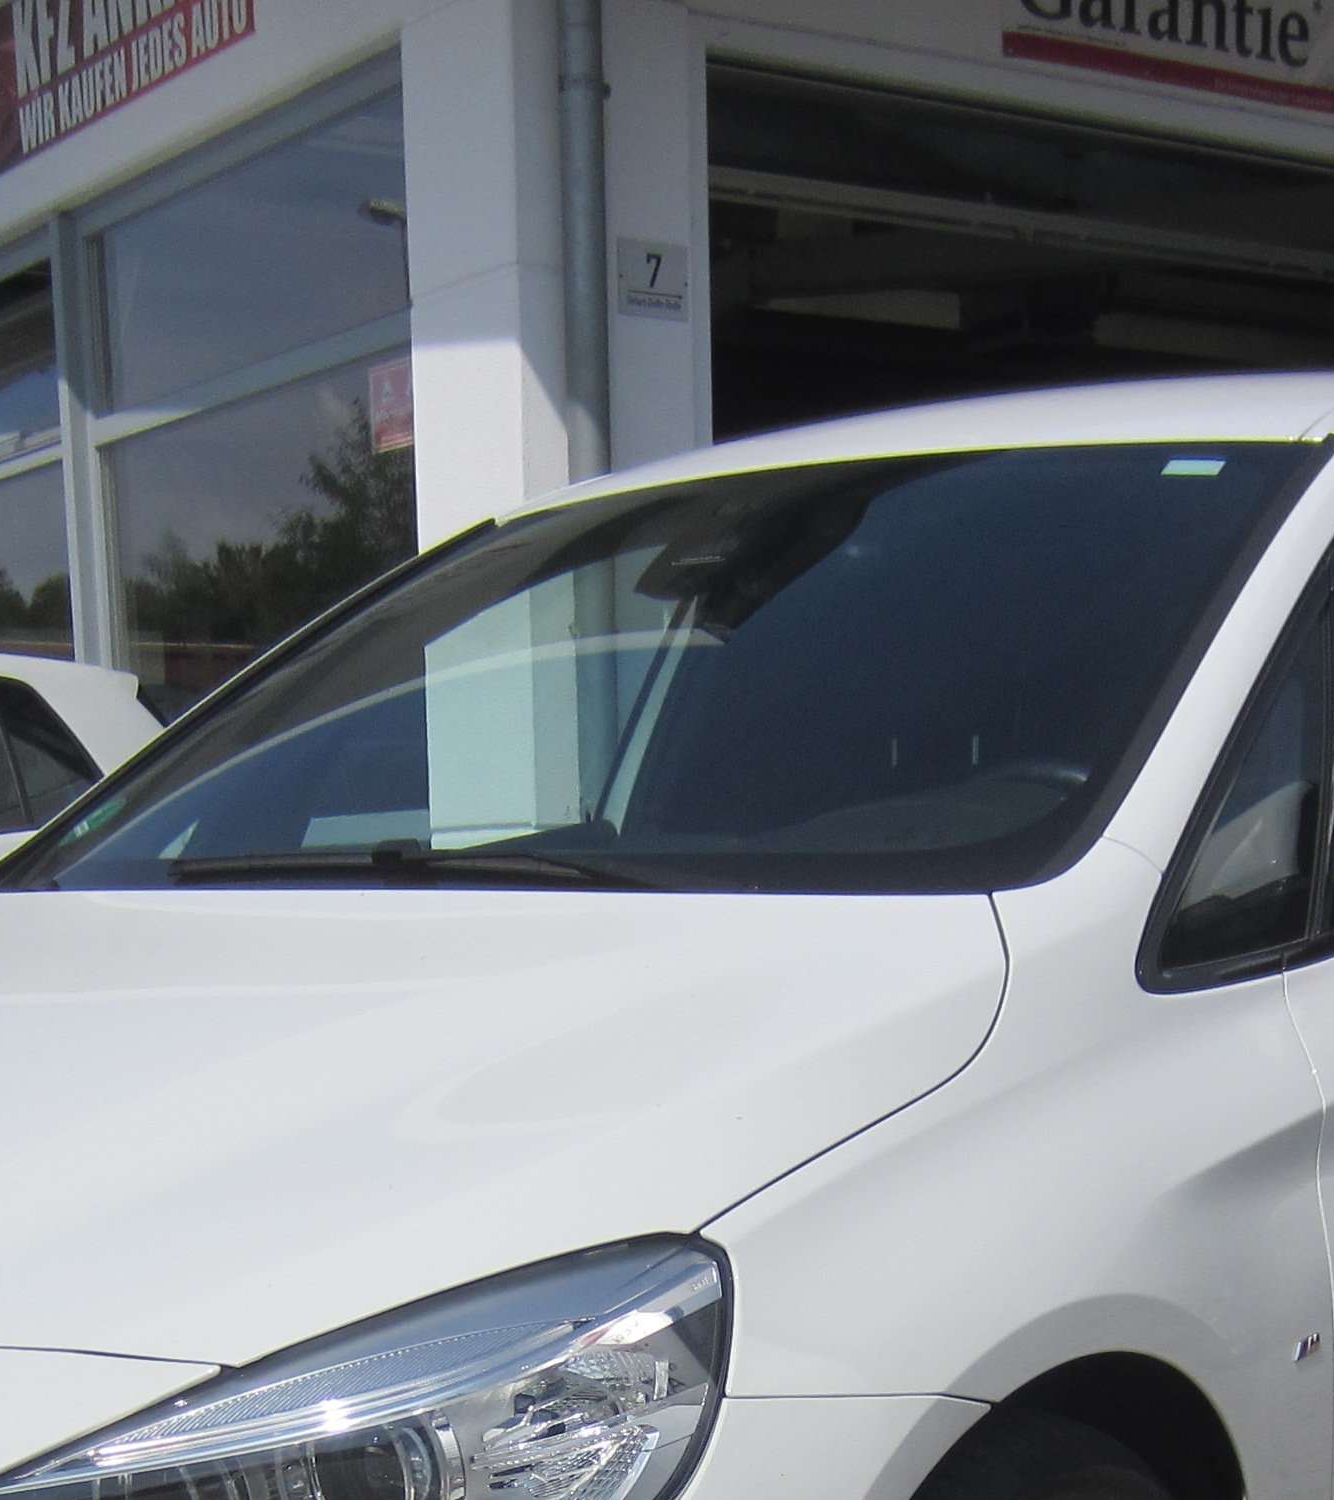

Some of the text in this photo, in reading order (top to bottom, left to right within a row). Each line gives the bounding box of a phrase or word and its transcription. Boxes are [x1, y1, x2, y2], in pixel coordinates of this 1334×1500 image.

[18, 0, 248, 155] WIR KAUFEN JEDES AUTO
[645, 252, 663, 289] 7
